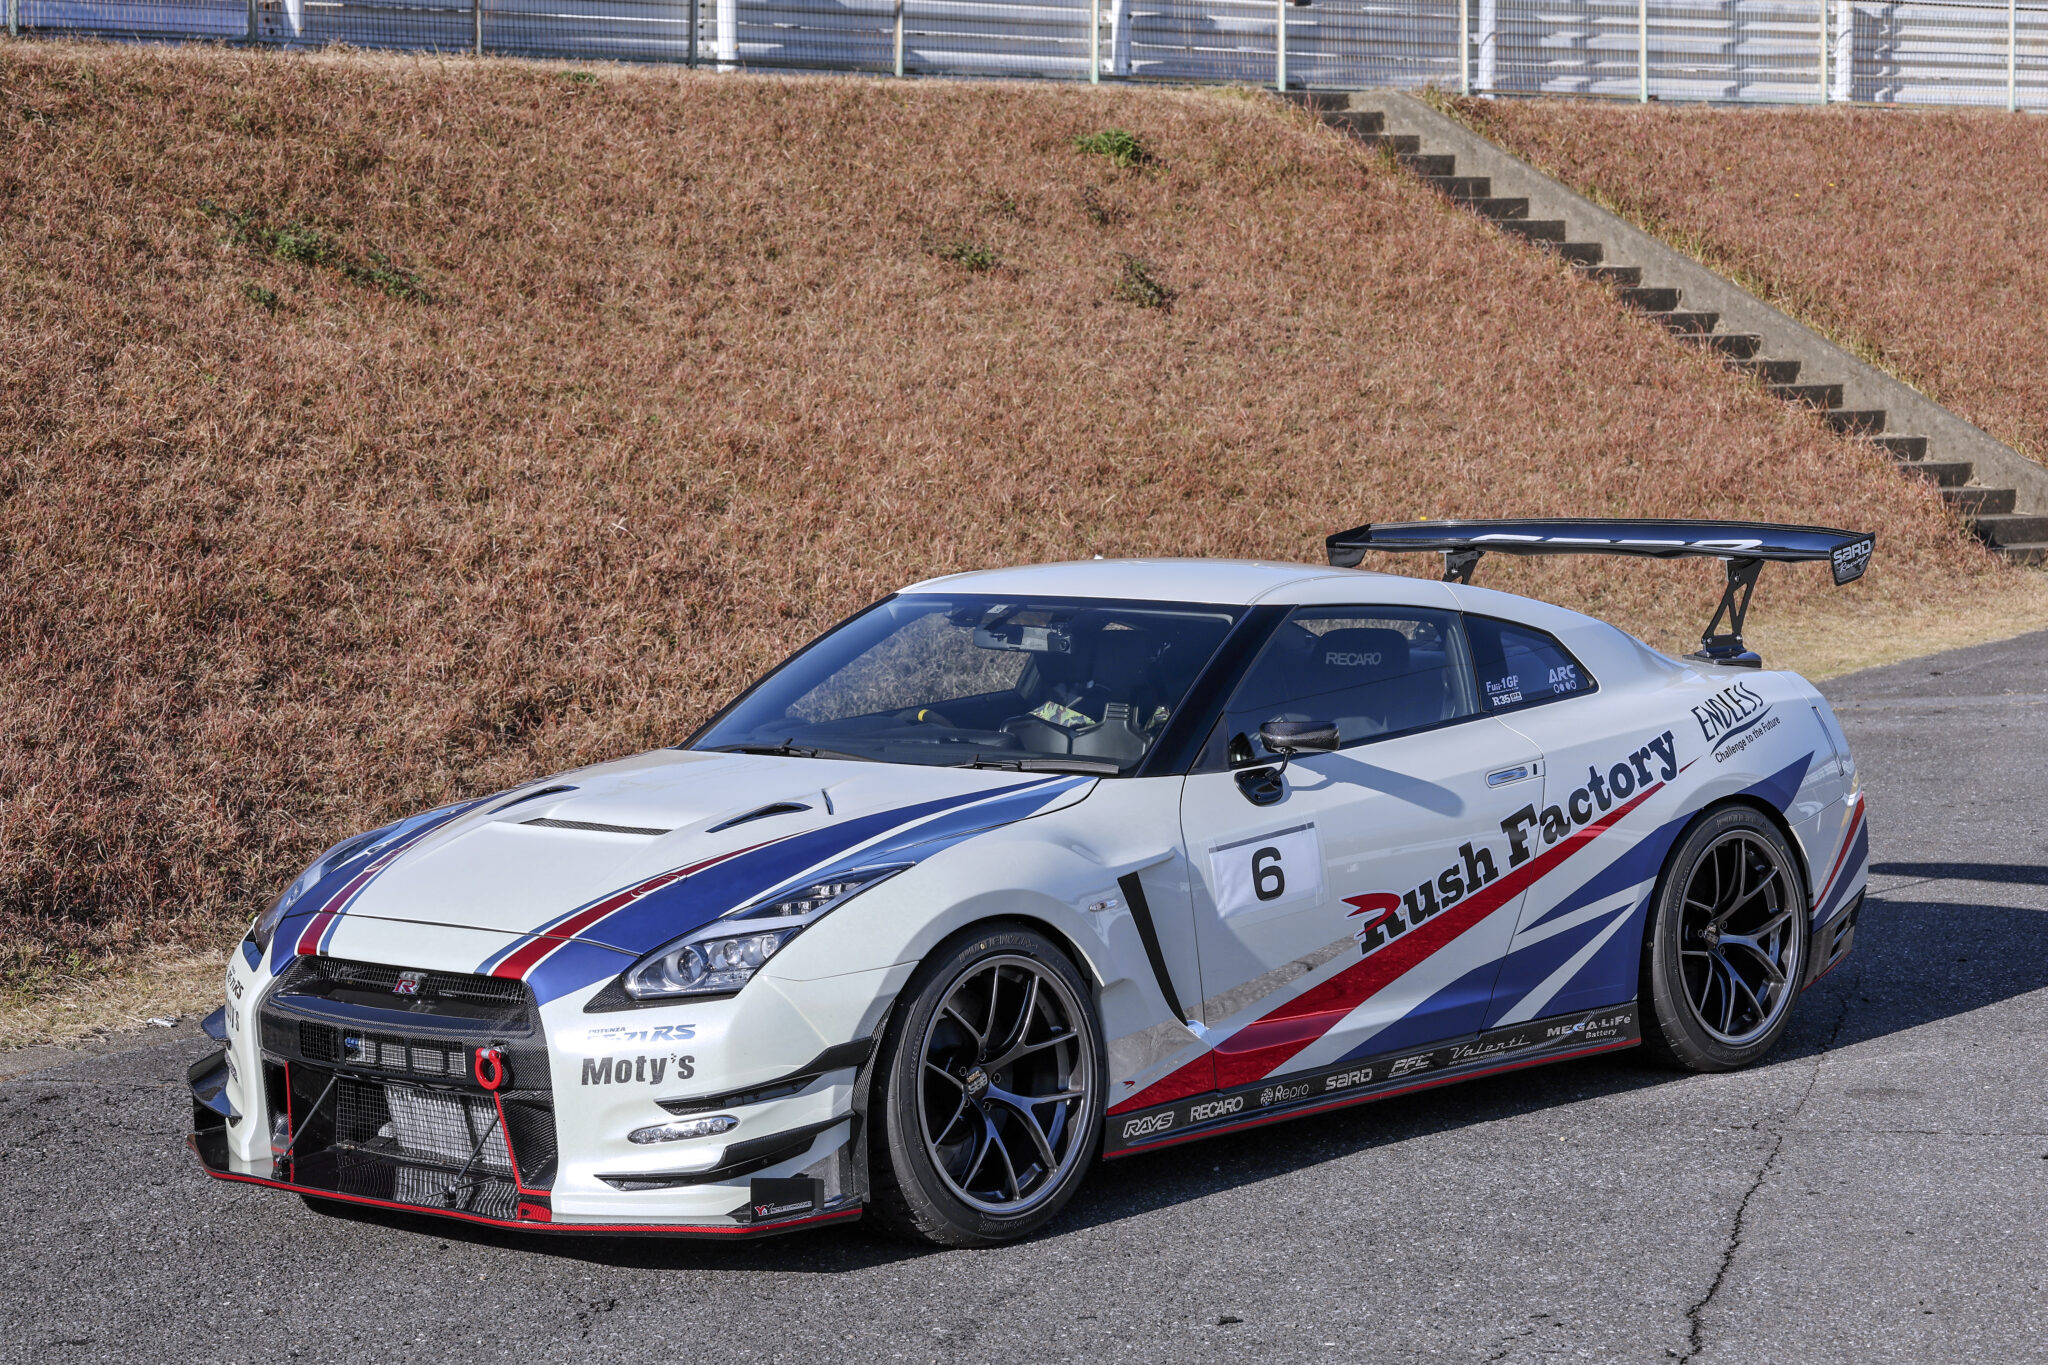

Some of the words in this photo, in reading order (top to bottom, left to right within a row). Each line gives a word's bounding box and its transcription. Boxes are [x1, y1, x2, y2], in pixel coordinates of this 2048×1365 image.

[1325, 651, 1382, 666] RECARO
[1548, 664, 1576, 684] ARC
[1690, 681, 1764, 742] ENDLESS
[1714, 738, 1748, 763] Challenge
[1745, 734, 1754, 744] to
[1752, 727, 1764, 739] the
[1761, 716, 1781, 732] Future
[1341, 841, 1499, 955] Rush
[1501, 730, 1675, 868] Factory
[1251, 846, 1286, 902] 6
[1450, 1034, 1532, 1060] Valenti
[1585, 1028, 1618, 1039] Battery
[581, 1053, 696, 1086] Moty's
[1273, 1083, 1310, 1103] Repro
[1190, 1096, 1244, 1122] RECARO
[1122, 1110, 1175, 1139] RAYS
